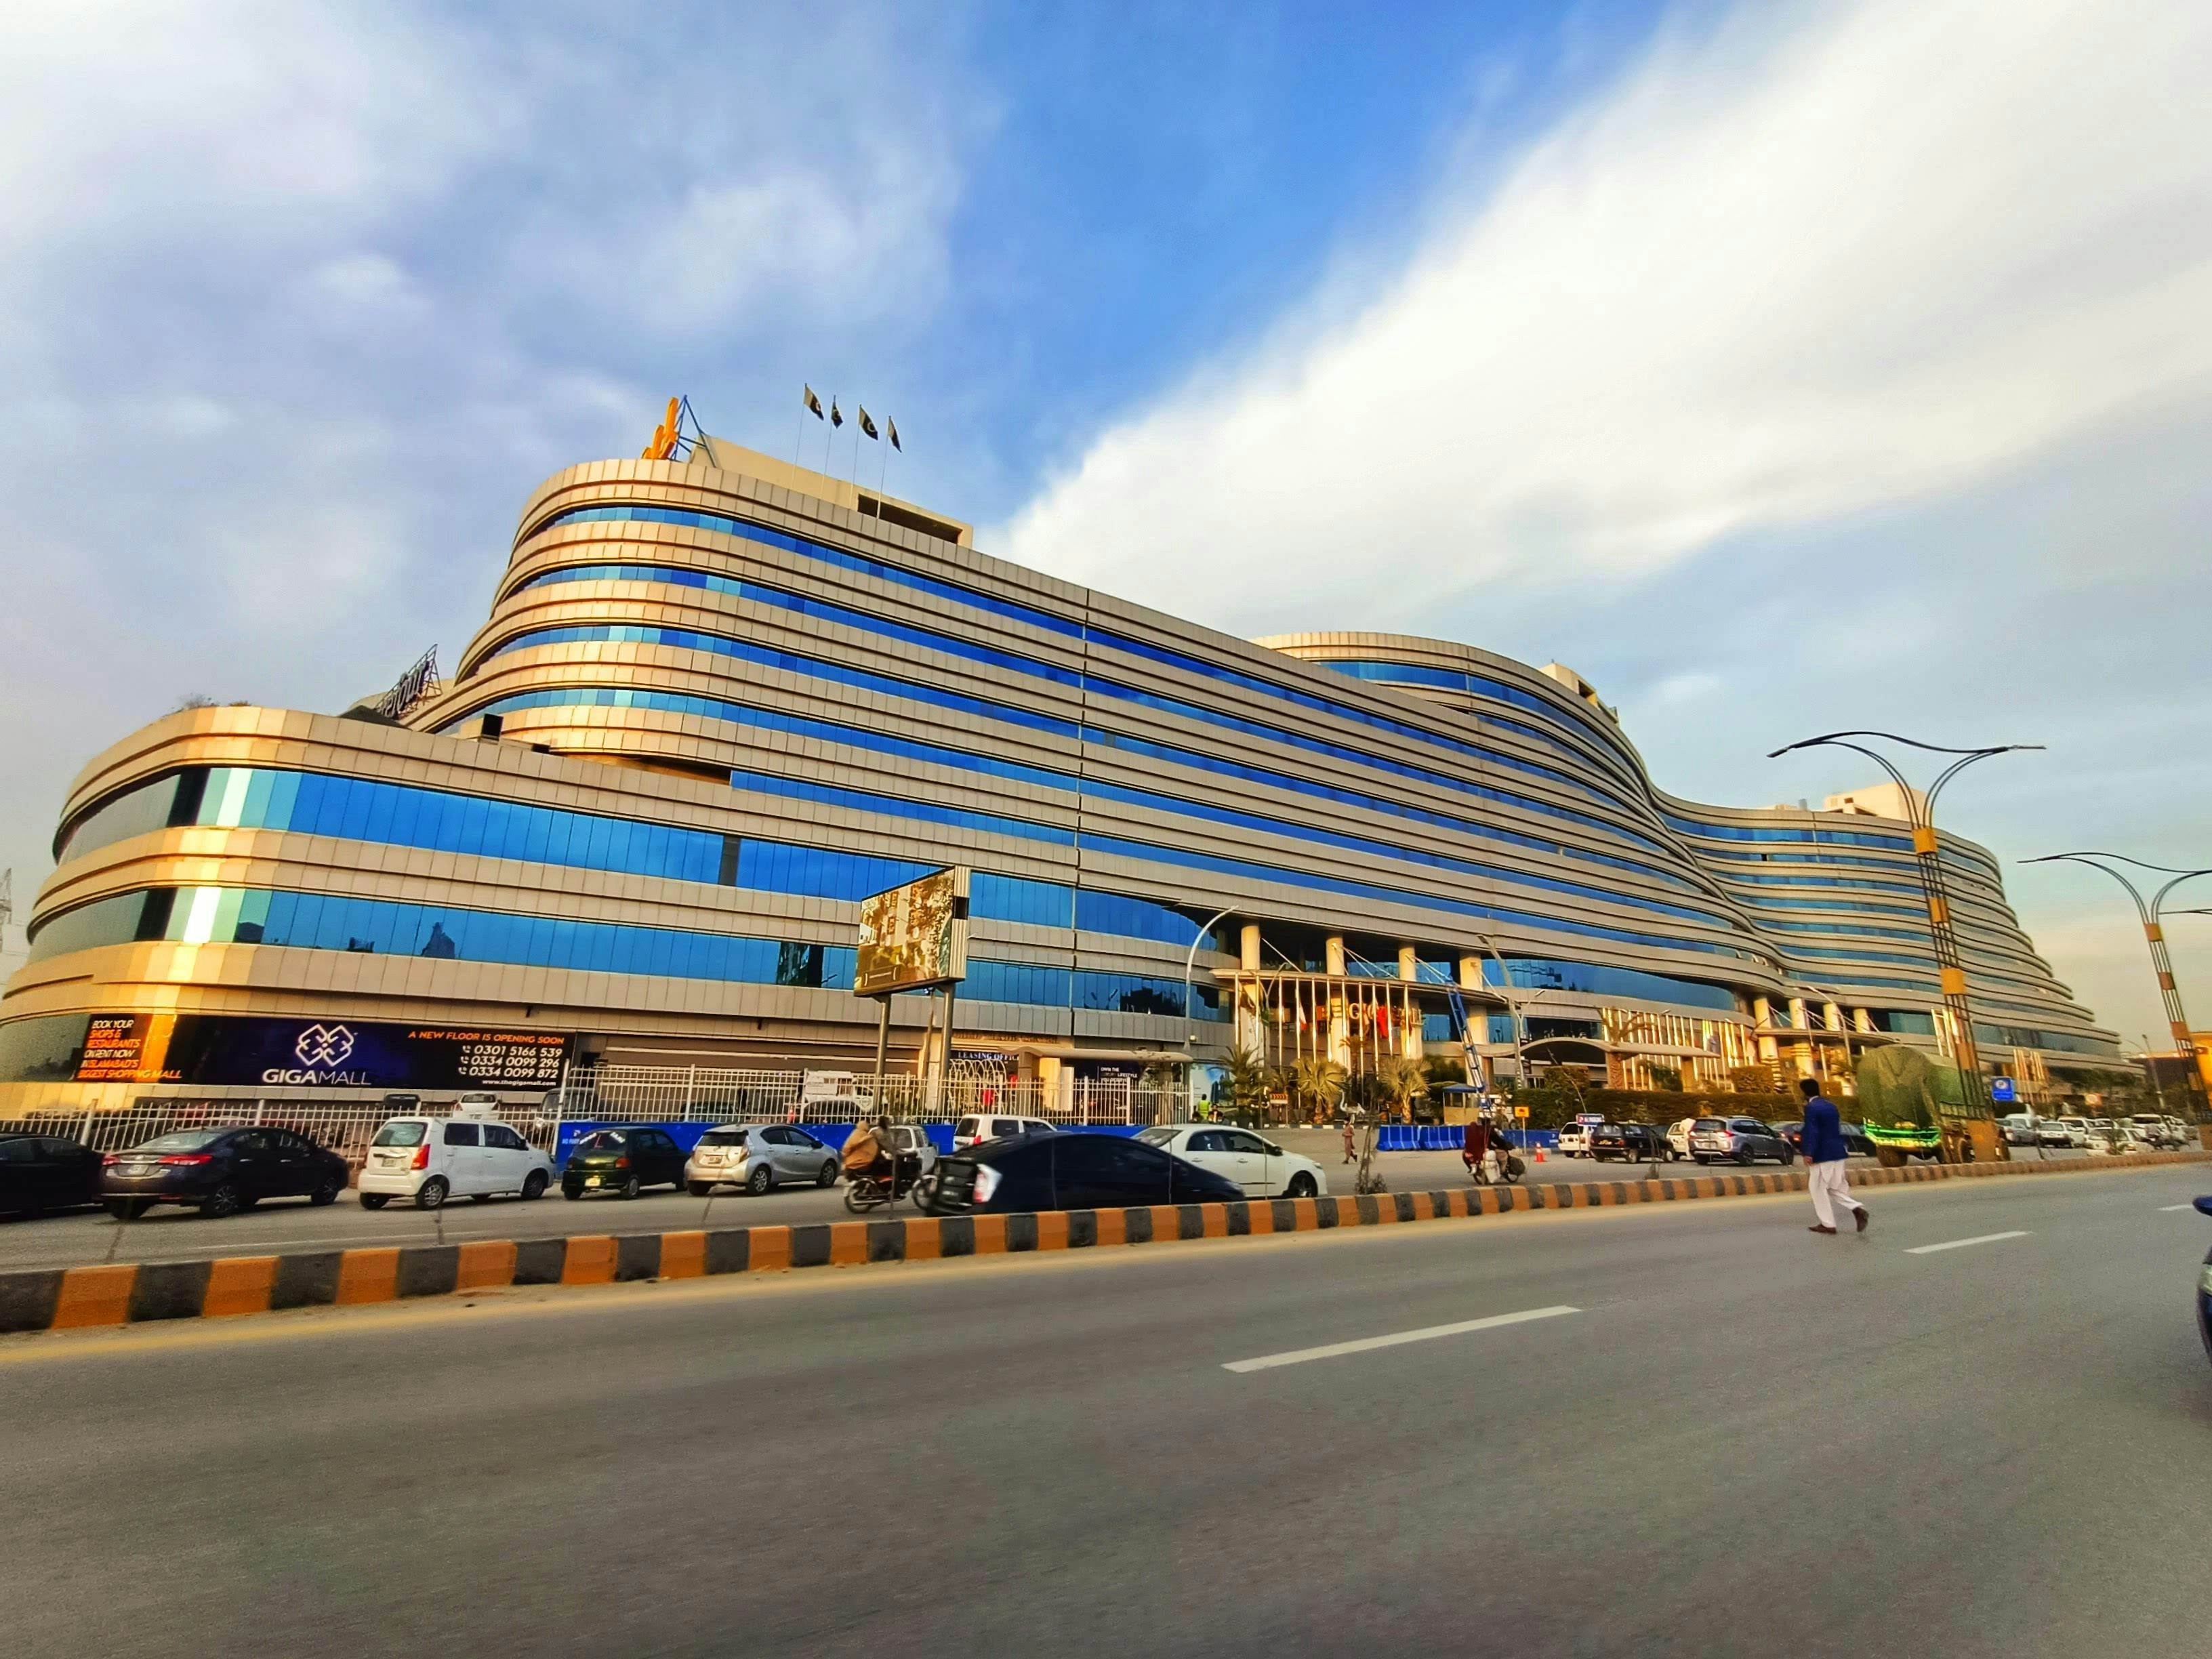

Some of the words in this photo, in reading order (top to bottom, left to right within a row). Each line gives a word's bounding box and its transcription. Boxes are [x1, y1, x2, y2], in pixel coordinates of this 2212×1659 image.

[91, 1020, 112, 1029] BOOK
[113, 1019, 134, 1028] YOUR
[89, 1029, 115, 1038] SHOPS
[419, 1031, 444, 1039] NEW
[446, 1032, 480, 1041] FLOOR
[493, 1034, 536, 1043] OPENING
[537, 1036, 565, 1044] SOON
[86, 1039, 141, 1048] RESTAURANTS
[112, 1050, 136, 1058] NOW
[474, 1045, 506, 1055] 0301
[510, 1046, 537, 1057] 5166
[539, 1048, 562, 1057] 539
[958, 1051, 992, 1060] LEASING
[470, 1056, 503, 1066] 0334
[506, 1057, 537, 1067] 0099
[539, 1058, 560, 1068] 296
[77, 1069, 108, 1078] BIGGEST
[106, 1069, 150, 1078] SHOPPING
[151, 1069, 182, 1078] MALL
[262, 1068, 371, 1085] GIGAMALL
[468, 1067, 501, 1076] 0334
[504, 1067, 535, 1078] 0099
[537, 1069, 558, 1078] 872
